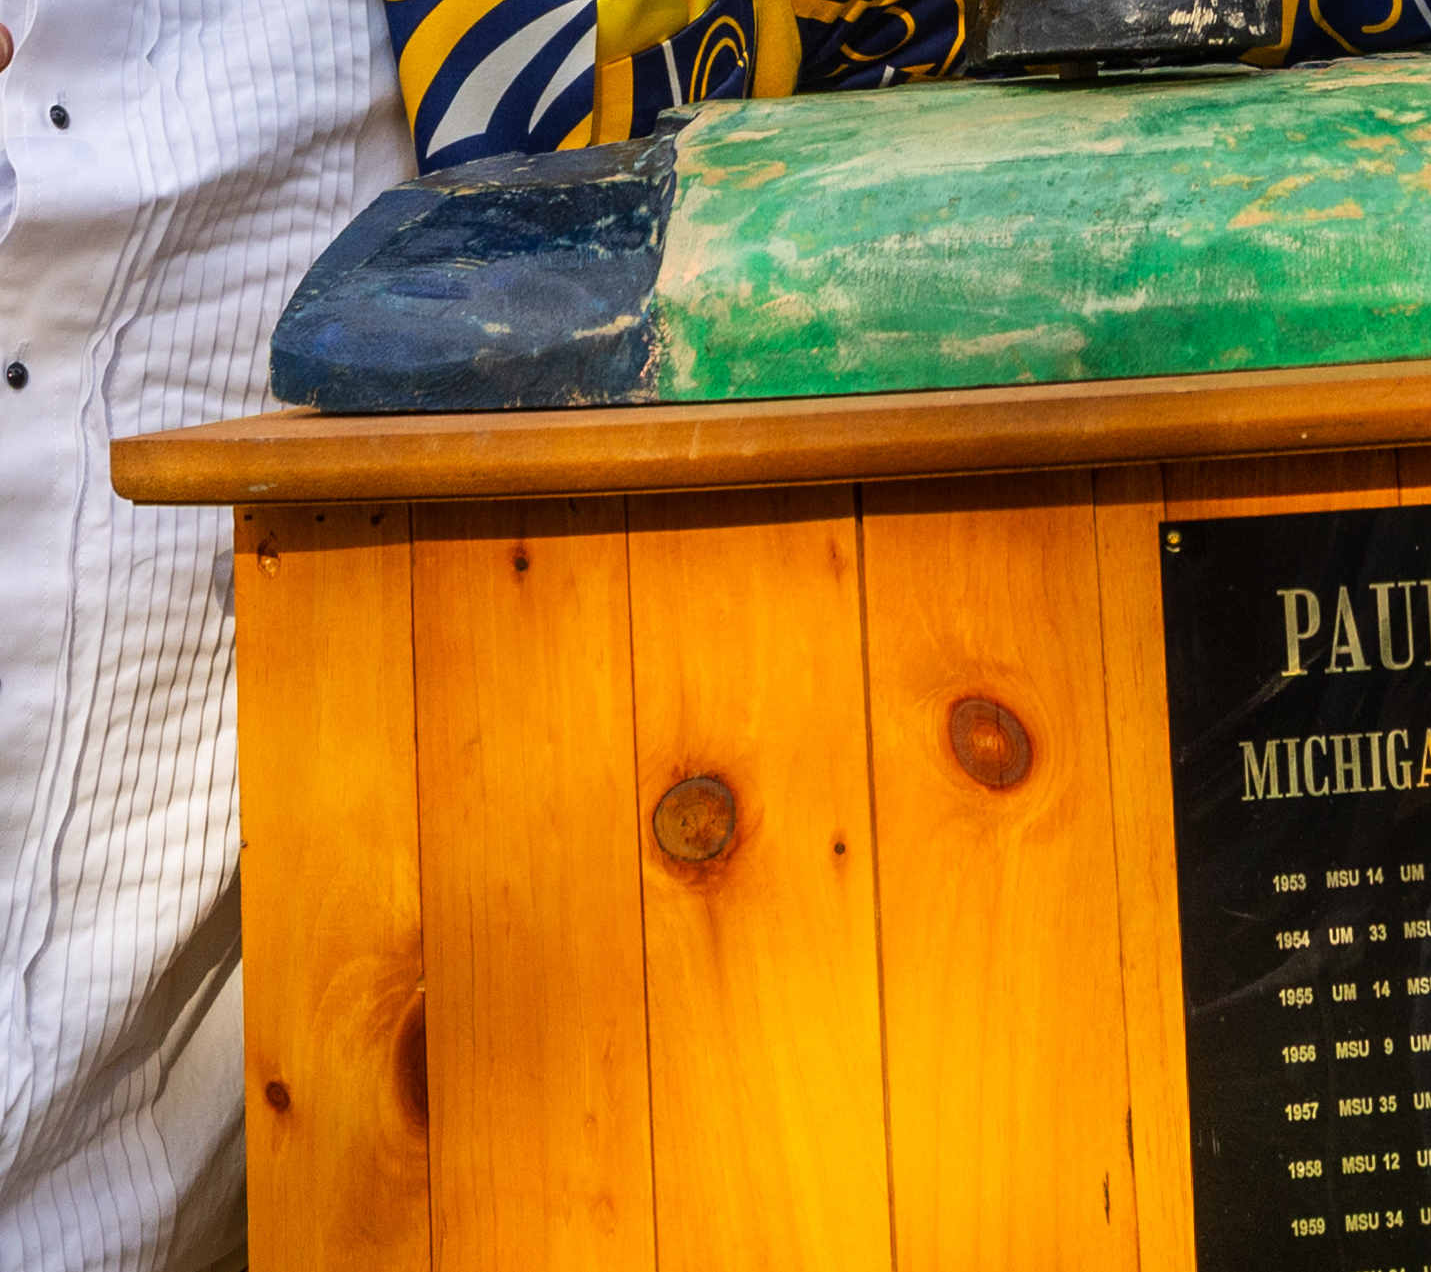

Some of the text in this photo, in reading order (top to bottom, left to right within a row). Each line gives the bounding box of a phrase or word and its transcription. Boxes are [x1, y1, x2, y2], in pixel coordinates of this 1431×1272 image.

[1272, 872, 1307, 893] 1953
[1325, 868, 1360, 889] MSU
[1365, 866, 1385, 886] 14
[1399, 863, 1425, 883] UM
[1275, 929, 1311, 951] 1954
[1328, 926, 1354, 946] UM
[1368, 923, 1388, 942] 33
[1278, 986, 1314, 1007] 1955
[1331, 982, 1358, 1003] UM
[1372, 979, 1392, 999] 14
[1281, 1043, 1317, 1064] 1956
[1335, 1038, 1370, 1060] MSU
[1383, 1036, 1394, 1056] 9
[1284, 1101, 1320, 1122] 1957
[1338, 1096, 1374, 1118] MSU
[1378, 1094, 1398, 1114] 35
[1287, 1158, 1323, 1180] 1958
[1341, 1153, 1377, 1175] MSU
[1382, 1151, 1401, 1171] 12
[1290, 1216, 1326, 1237] 1959
[1344, 1211, 1380, 1233] MSU
[1384, 1209, 1405, 1229] 34
